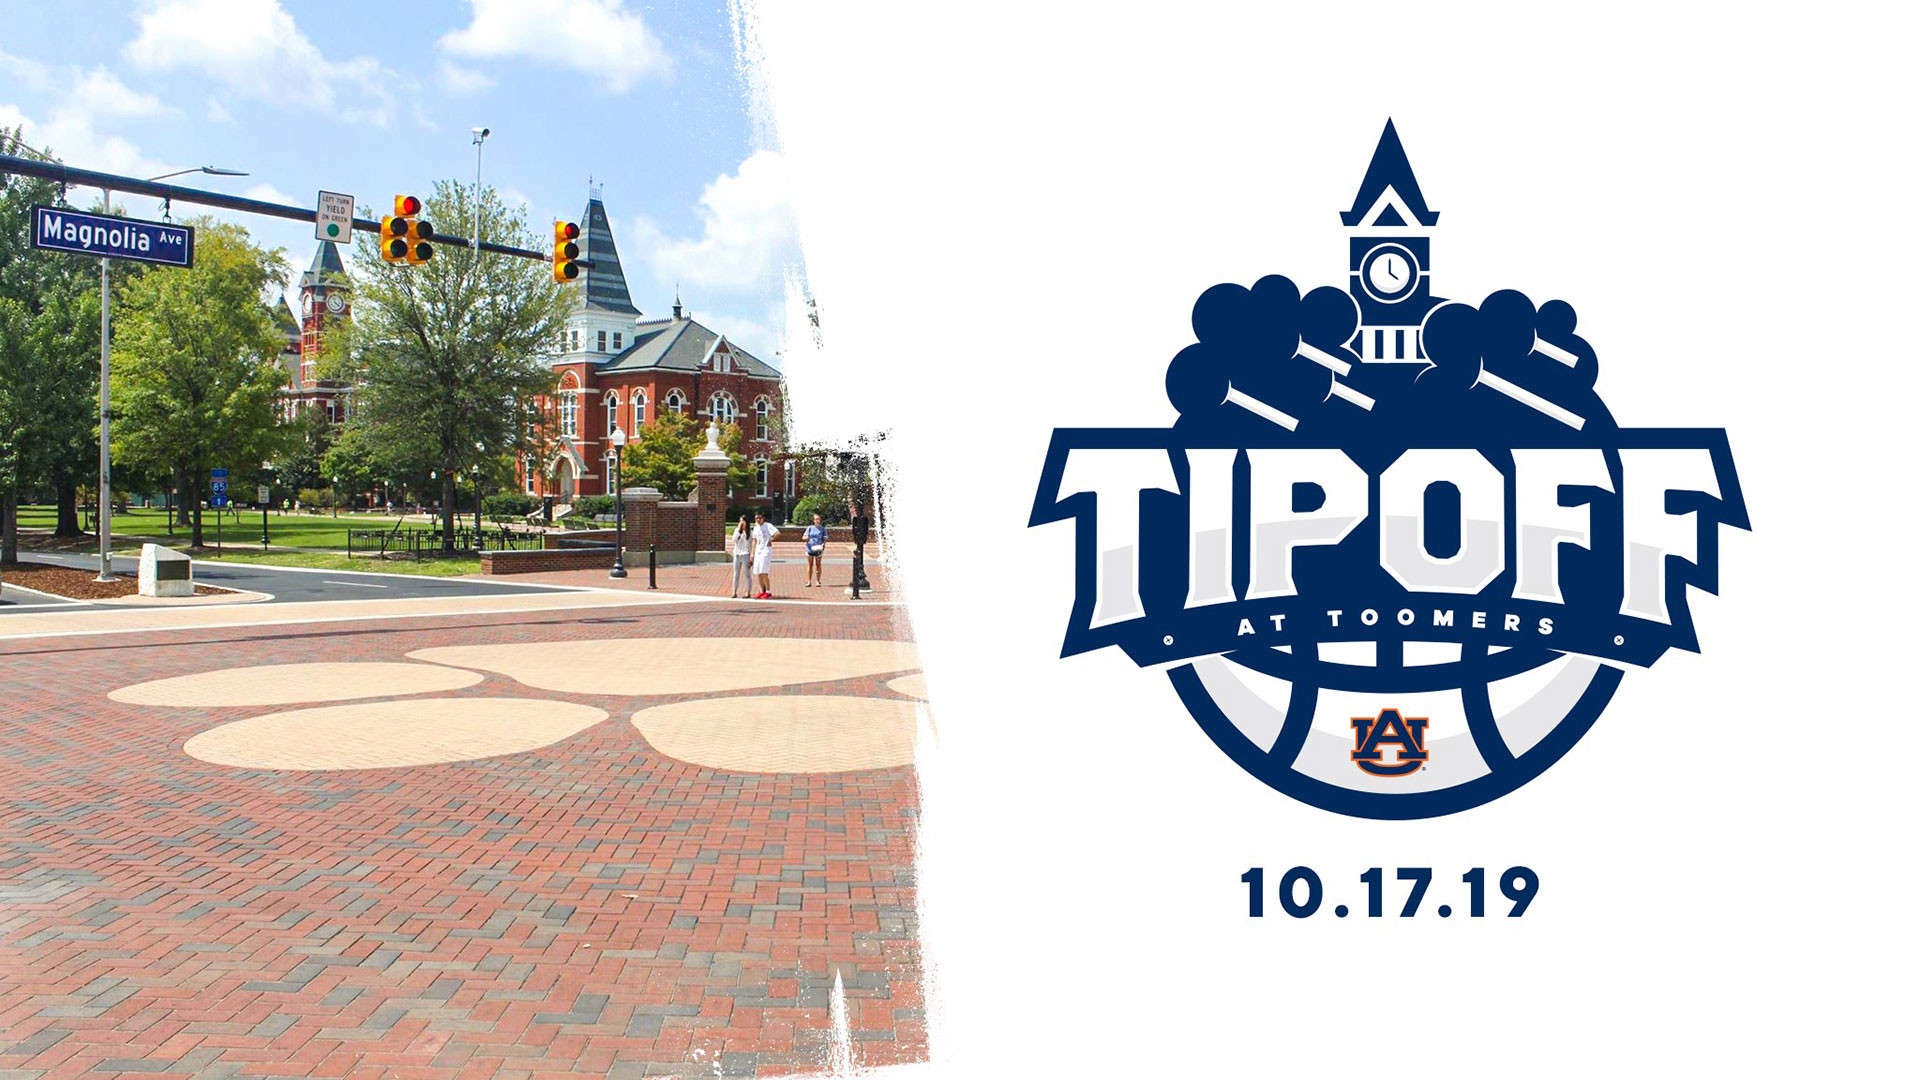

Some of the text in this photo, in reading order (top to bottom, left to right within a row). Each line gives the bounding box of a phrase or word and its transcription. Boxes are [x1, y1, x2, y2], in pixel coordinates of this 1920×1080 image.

[326, 204, 345, 214] YIELD
[44, 214, 183, 252] Magnolia Ave
[213, 482, 225, 491] 85
